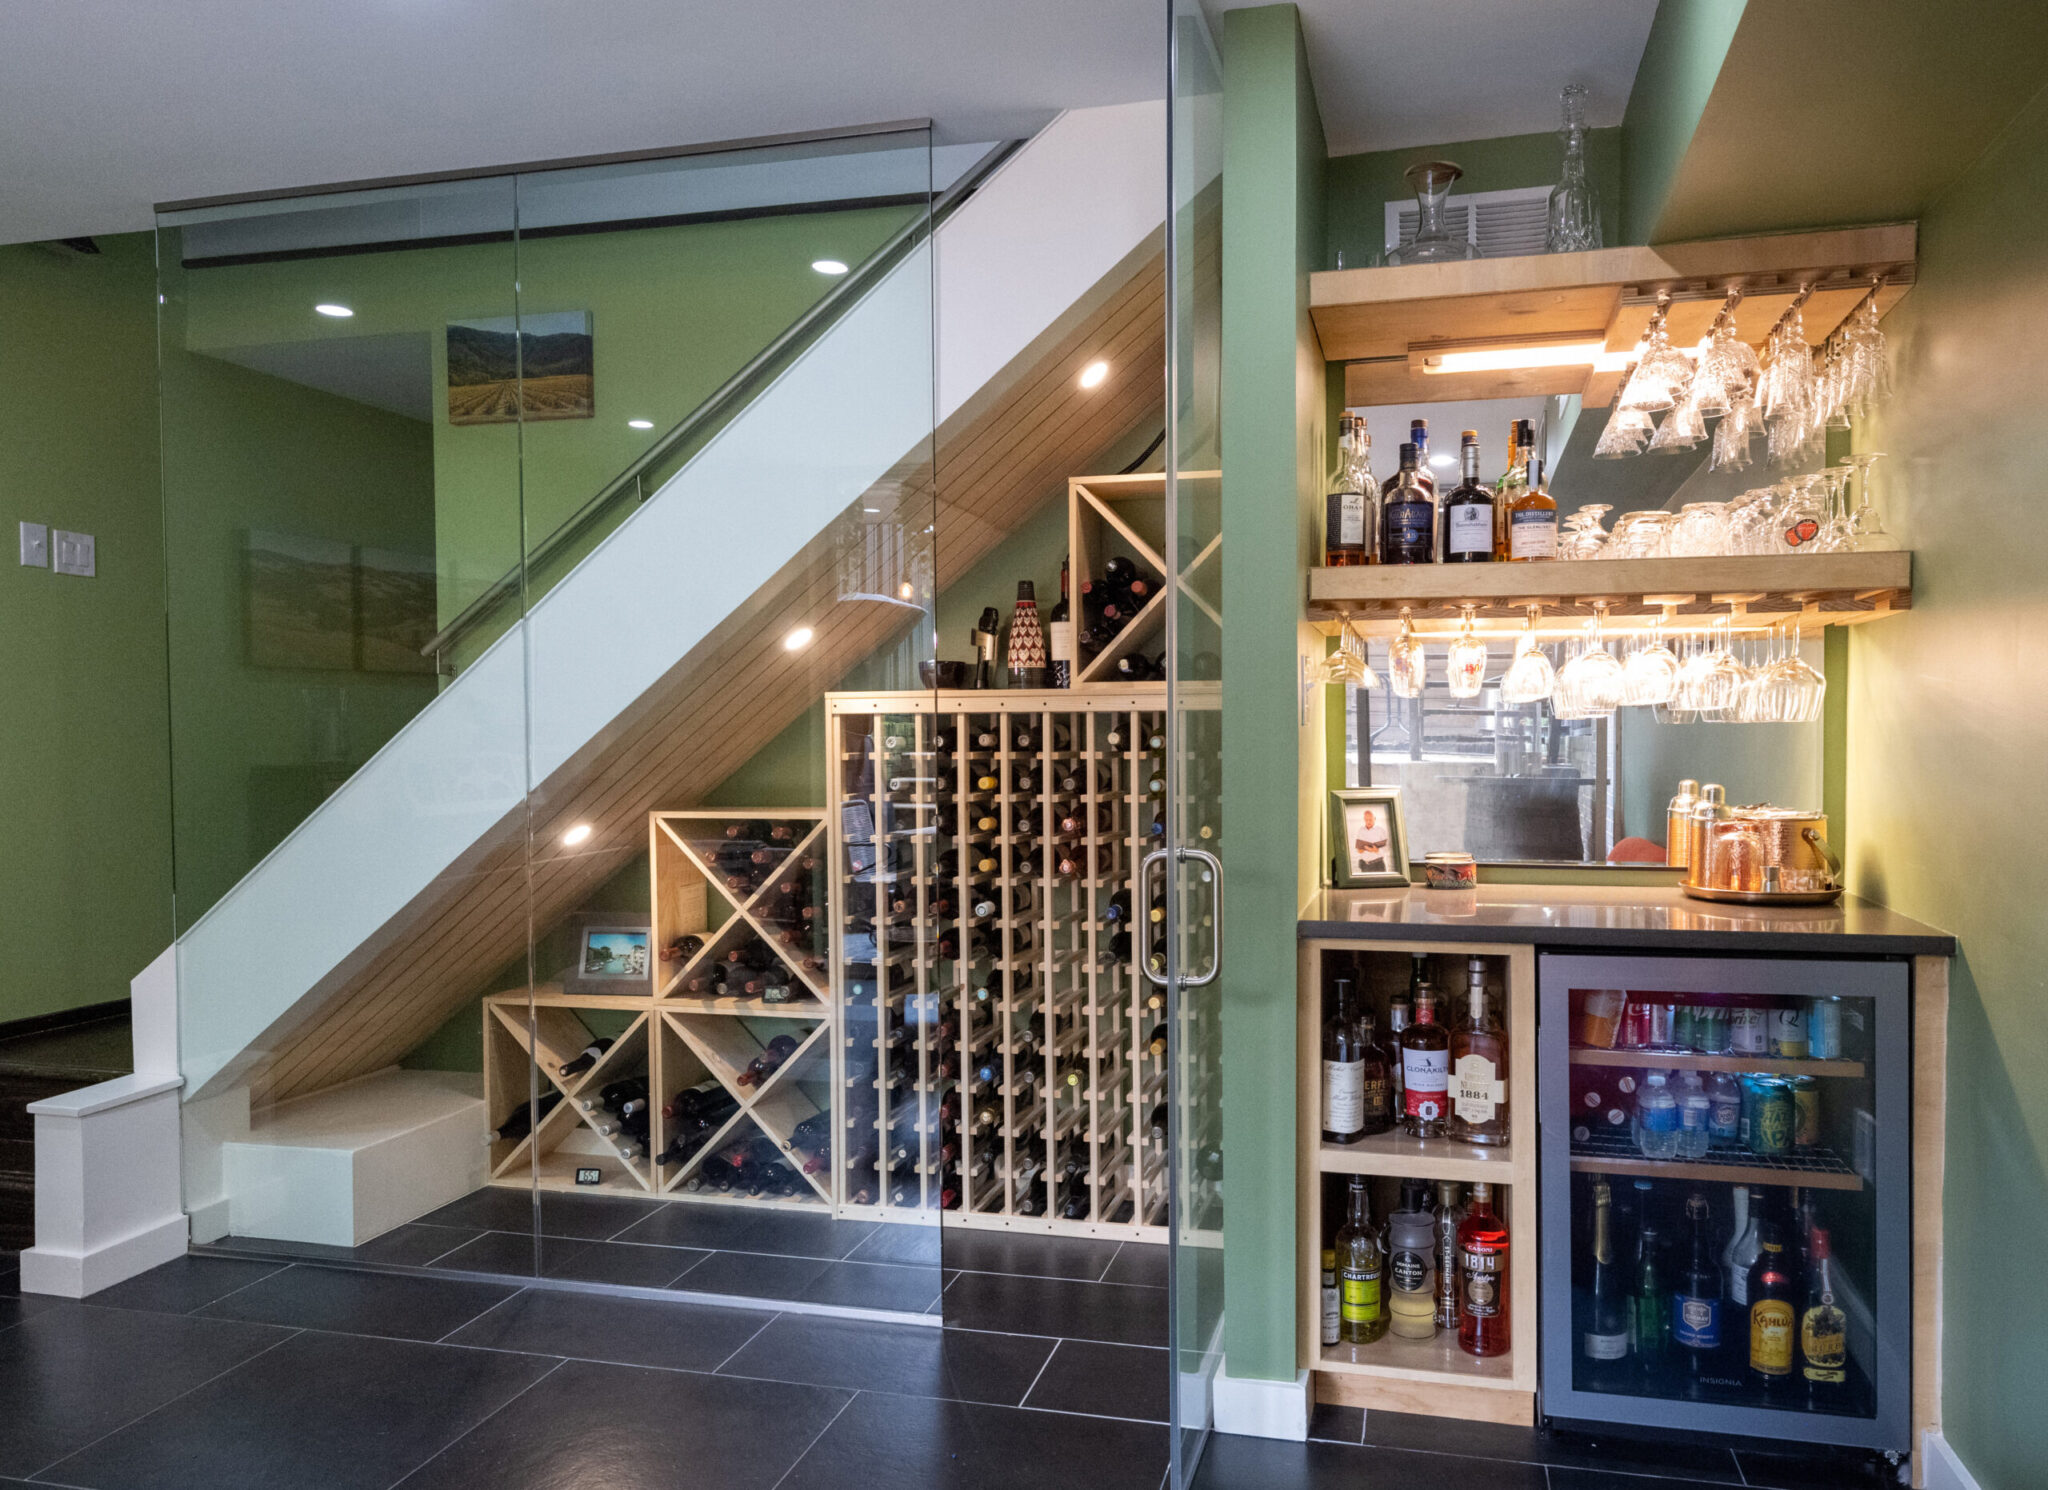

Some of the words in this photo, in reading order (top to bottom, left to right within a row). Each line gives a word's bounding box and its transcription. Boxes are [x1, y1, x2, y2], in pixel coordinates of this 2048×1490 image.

[1459, 1089, 1489, 1100] 1884
[1396, 1261, 1421, 1269] DOMAINE
[1464, 1253, 1495, 1270] 1814
[1343, 1271, 1381, 1281] CHARTREU
[1394, 1267, 1423, 1276] CANTON
[1699, 1376, 1743, 1387] INSIGNIA
